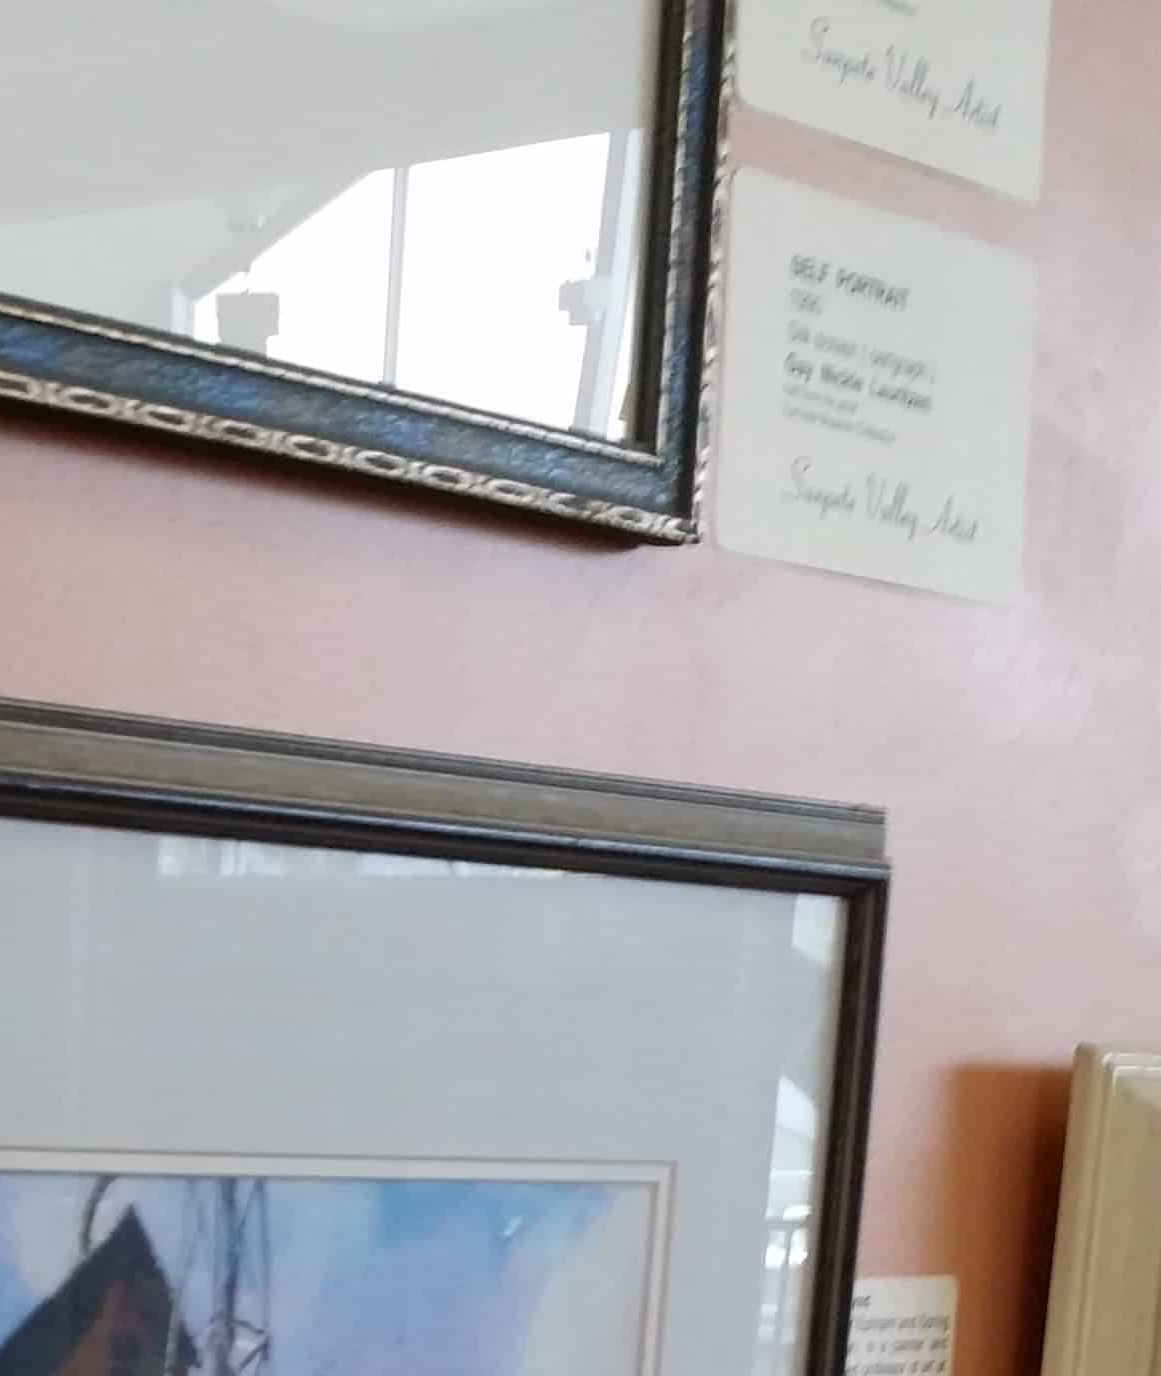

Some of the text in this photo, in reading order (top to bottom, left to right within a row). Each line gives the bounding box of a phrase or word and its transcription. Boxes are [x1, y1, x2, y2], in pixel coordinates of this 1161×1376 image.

[884, 43, 942, 122] Valley
[835, 266, 912, 314] PORTRAIT
[863, 470, 920, 543] Valley
